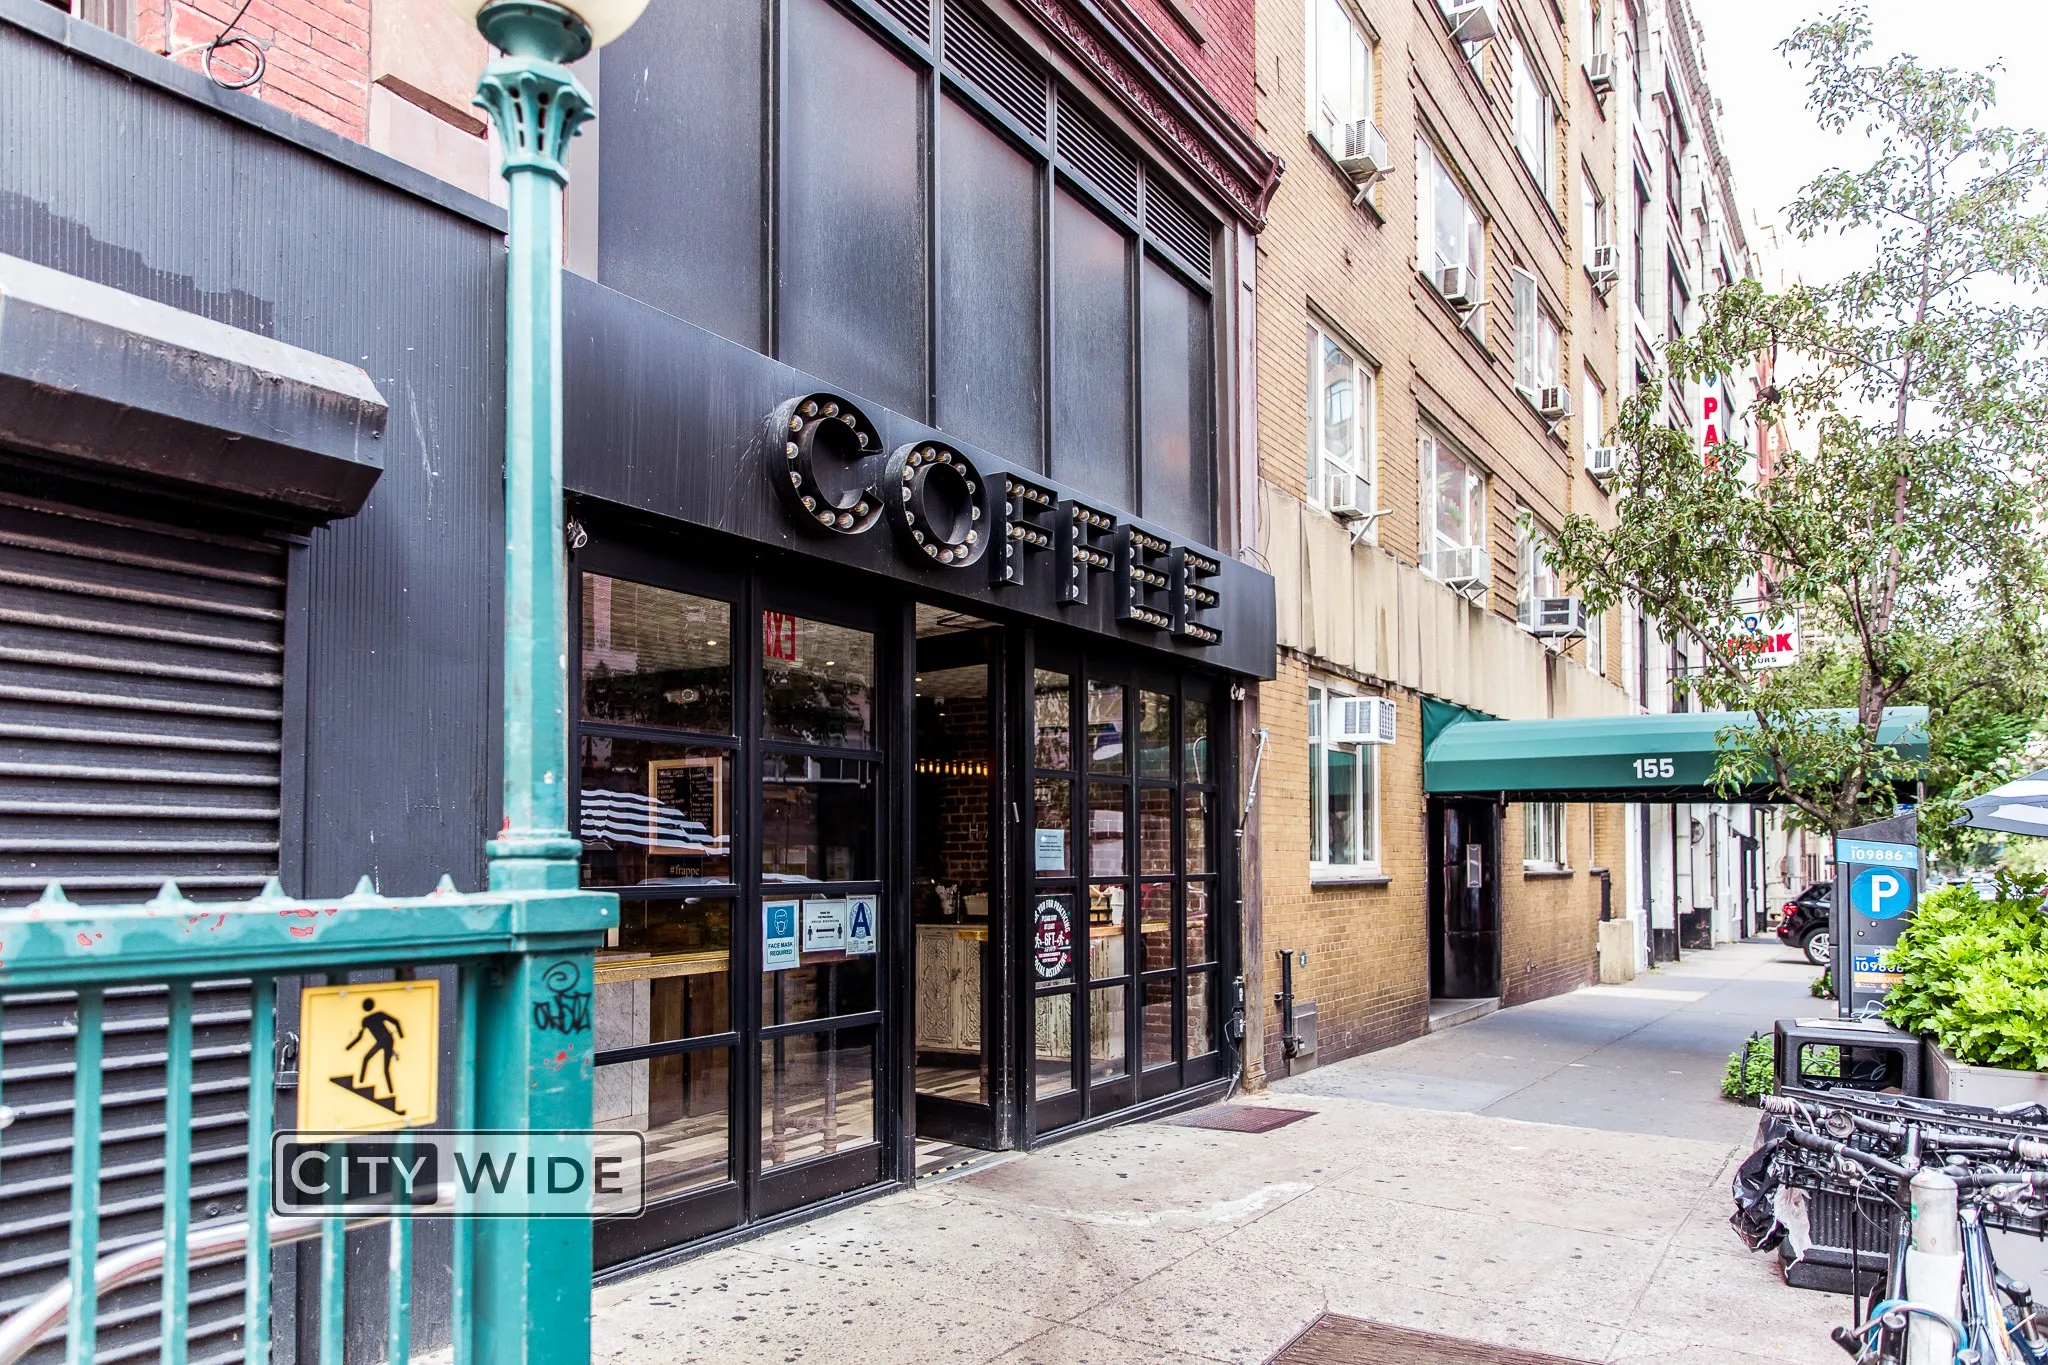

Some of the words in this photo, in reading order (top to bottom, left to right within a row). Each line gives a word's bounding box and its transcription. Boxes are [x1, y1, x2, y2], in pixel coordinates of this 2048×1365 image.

[1703, 397, 1719, 497] PAR
[767, 391, 1223, 646] COFFEE
[1633, 758, 1675, 779] 155
[1851, 849, 1903, 861] 109886
[670, 864, 700, 878] #frappe
[1871, 874, 1900, 912] P
[850, 902, 872, 938] A
[769, 948, 793, 957] REQUIRED
